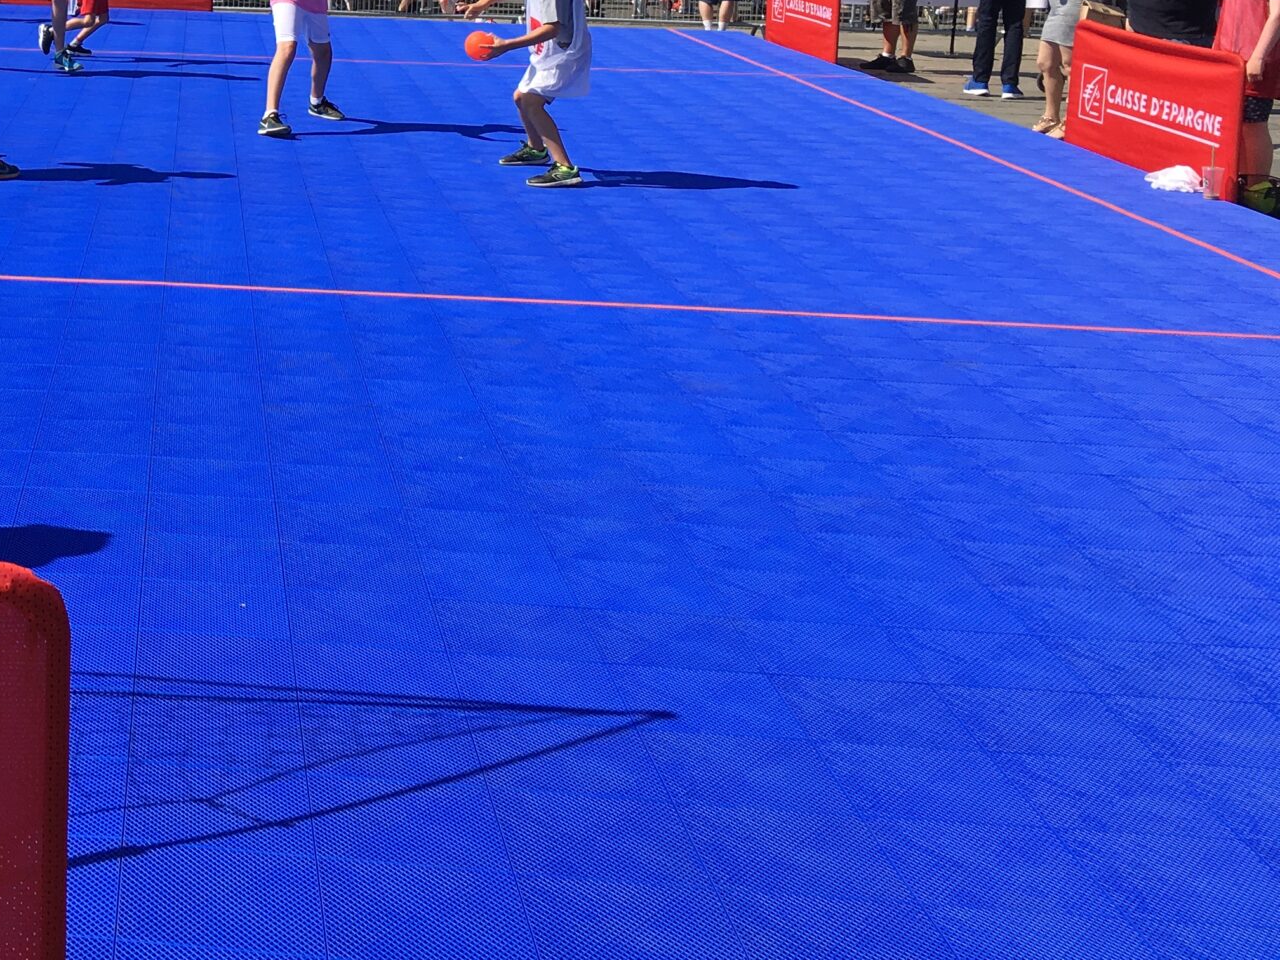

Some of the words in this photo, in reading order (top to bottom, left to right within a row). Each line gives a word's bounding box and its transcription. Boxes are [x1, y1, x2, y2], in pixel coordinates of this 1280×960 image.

[805, 1, 833, 21] D'EPARGNE
[1107, 84, 1148, 113] CAISSE
[1150, 96, 1223, 137] D'EPARGNE
